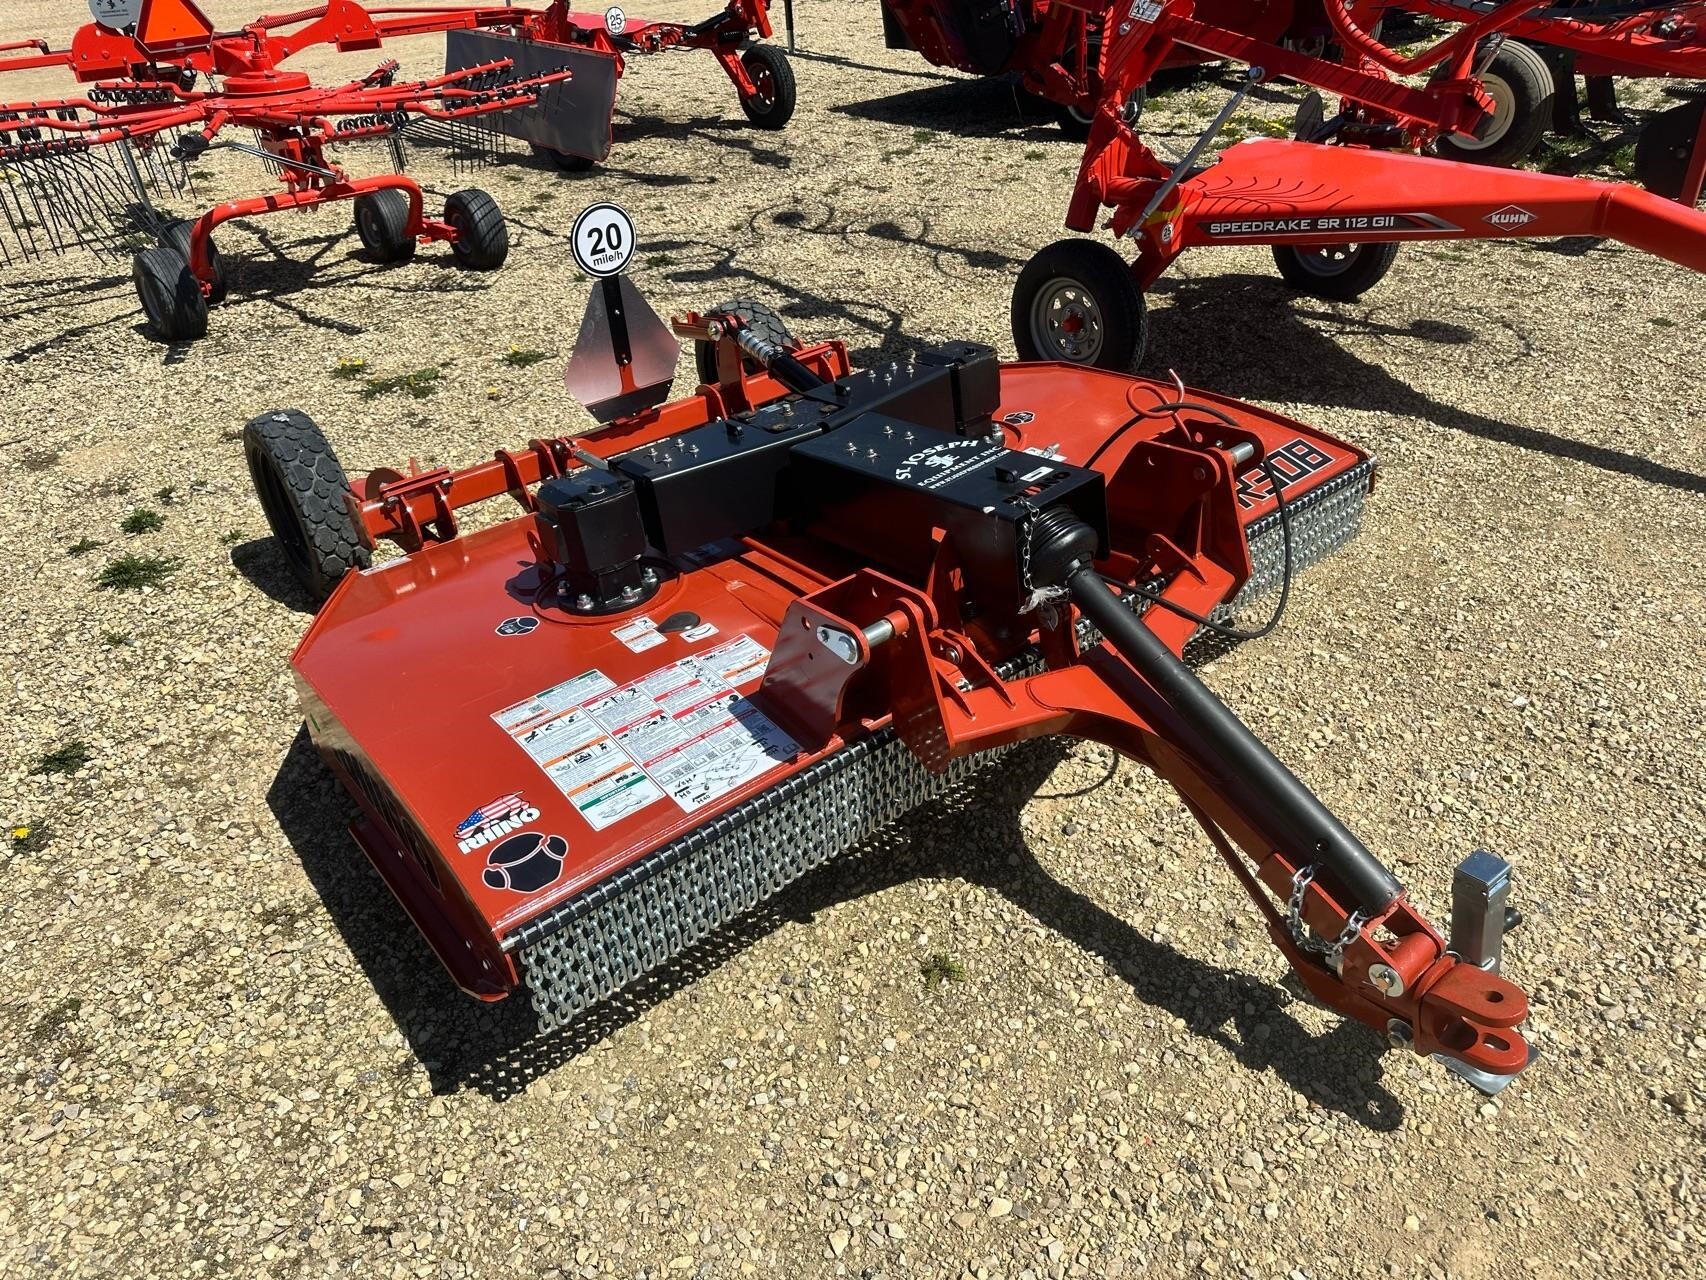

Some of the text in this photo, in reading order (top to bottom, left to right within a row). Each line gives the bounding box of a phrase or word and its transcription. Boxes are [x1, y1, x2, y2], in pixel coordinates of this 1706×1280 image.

[610, 14, 622, 26] 25
[1210, 219, 1311, 233] SPEEDRAKE
[1317, 218, 1340, 229] SR
[1344, 217, 1368, 229] 112
[1491, 214, 1529, 223] KUHN
[587, 223, 622, 256] 20
[593, 251, 624, 266] mile/h
[901, 440, 979, 466] JOSEPH
[917, 455, 980, 486] EQUIPMENT
[457, 808, 541, 855] RHINO
